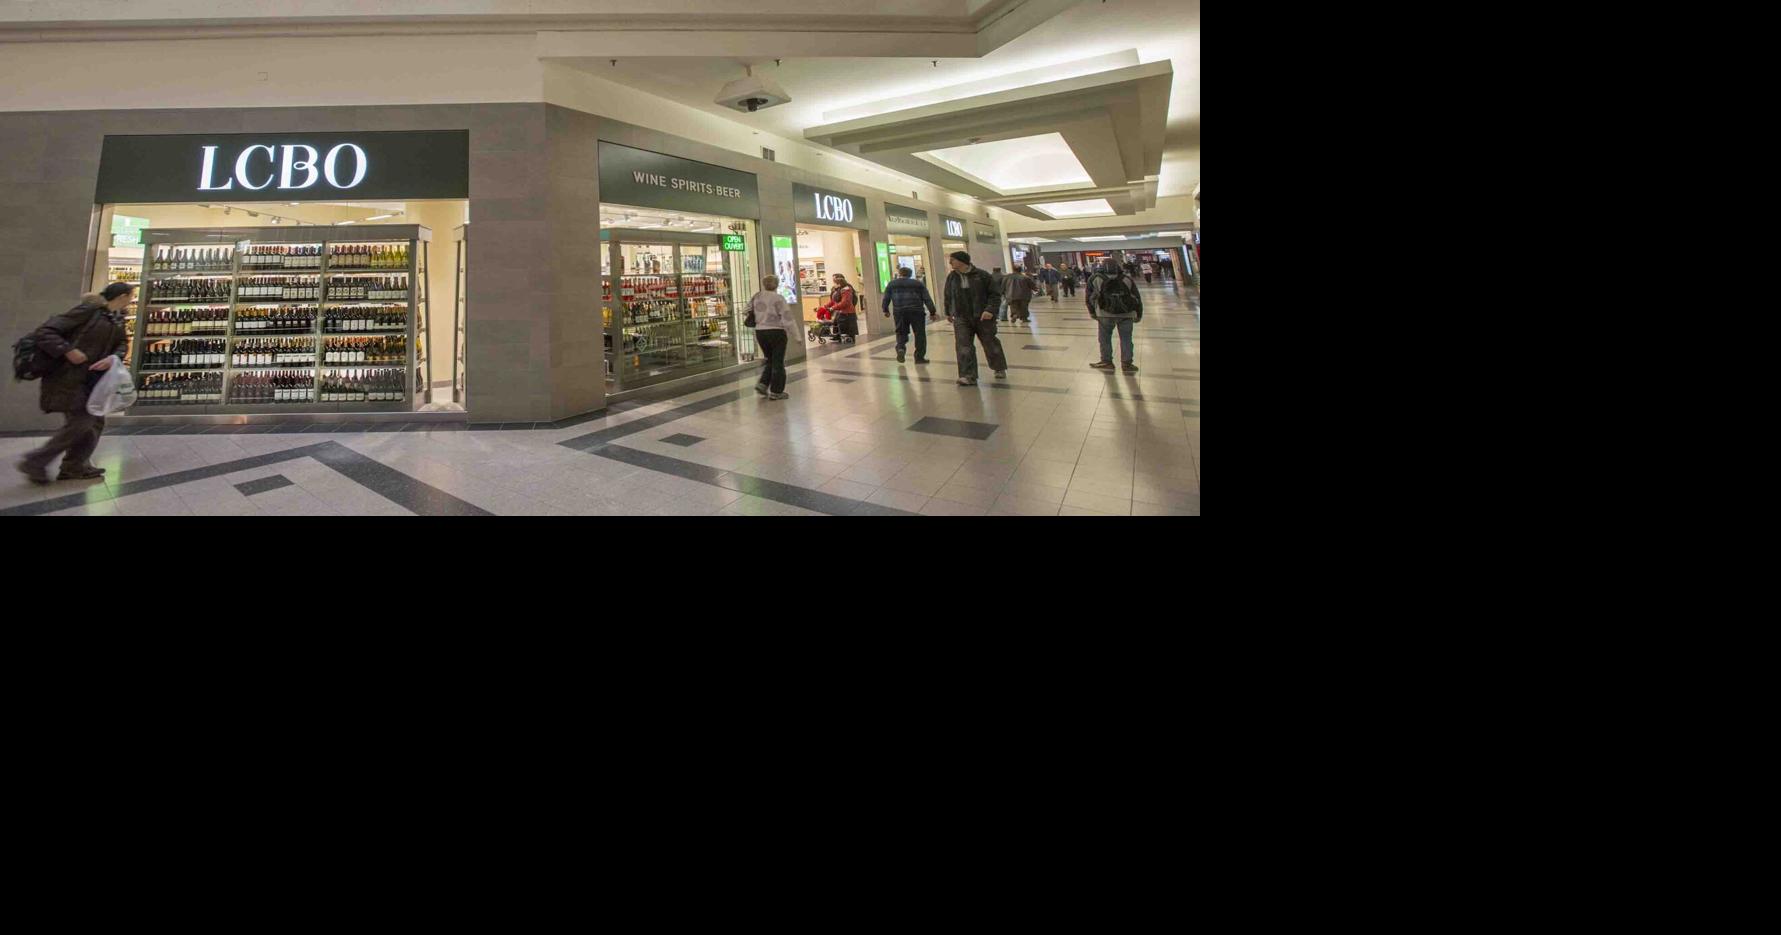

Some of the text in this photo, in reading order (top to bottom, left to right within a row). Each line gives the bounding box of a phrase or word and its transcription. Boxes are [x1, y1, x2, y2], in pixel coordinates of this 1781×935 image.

[197, 143, 367, 190] LCBO
[633, 171, 667, 187] WINE
[814, 192, 853, 222] LCBO
[725, 242, 744, 250] OUVERT
